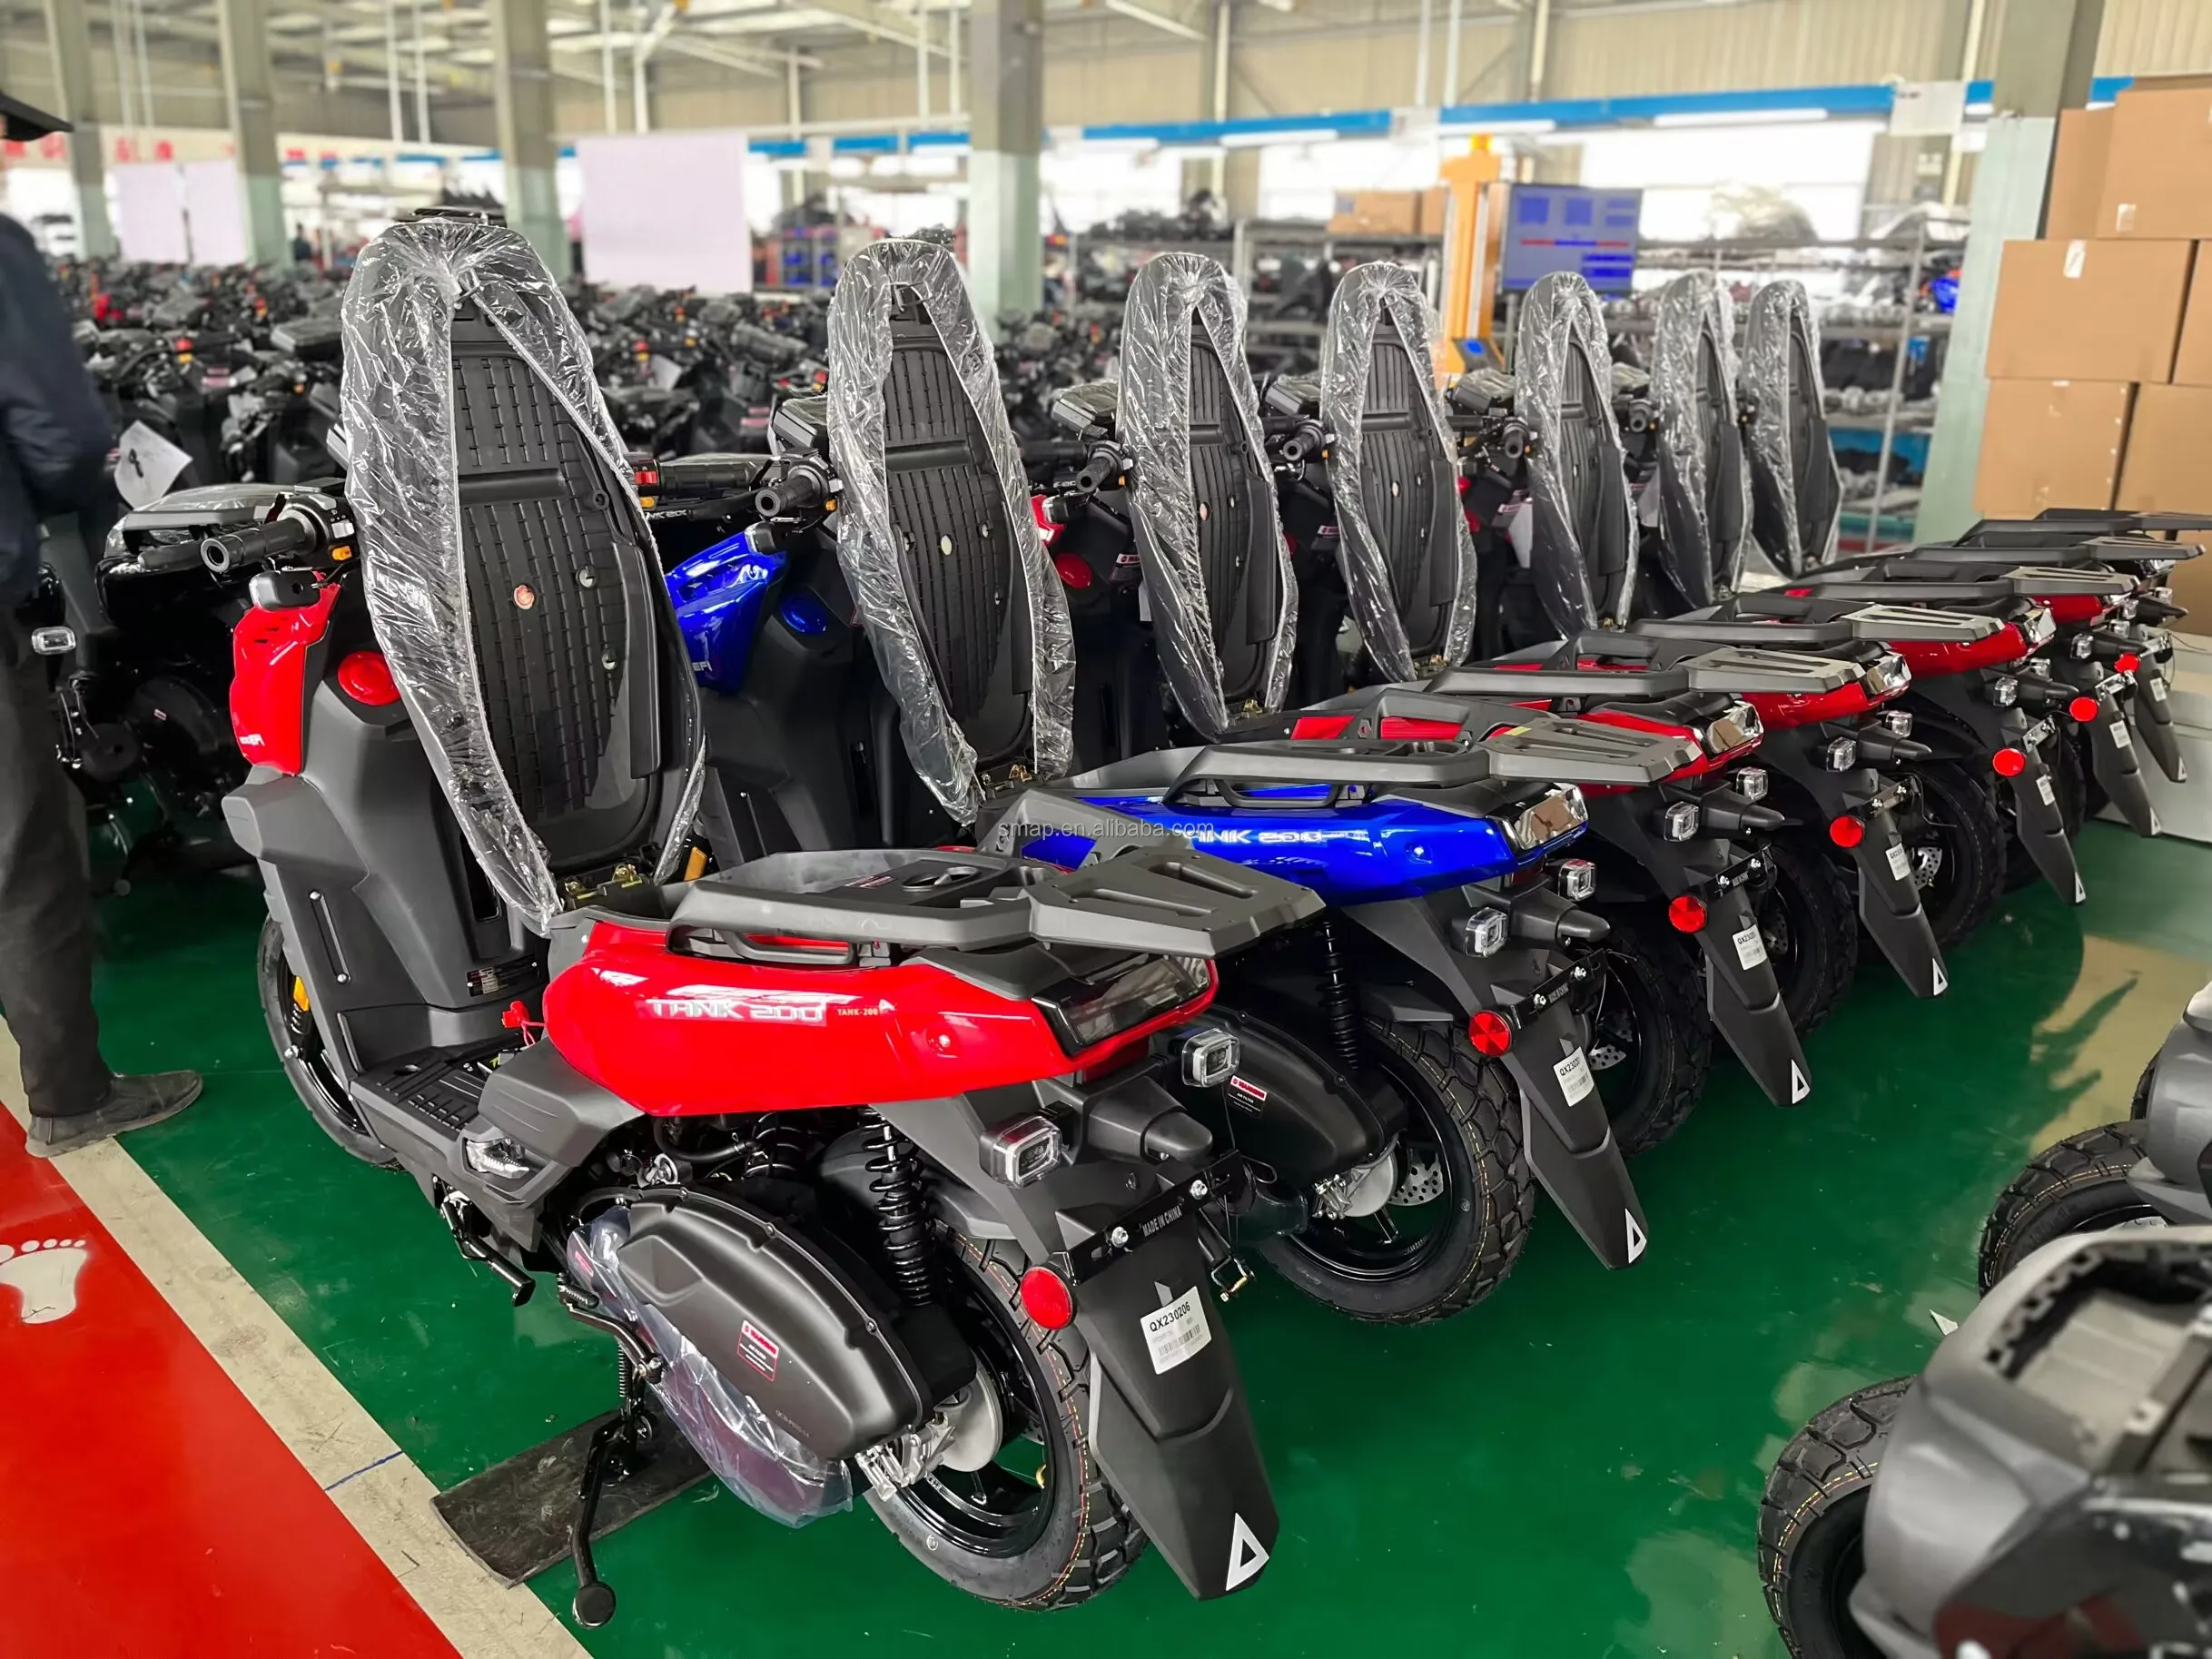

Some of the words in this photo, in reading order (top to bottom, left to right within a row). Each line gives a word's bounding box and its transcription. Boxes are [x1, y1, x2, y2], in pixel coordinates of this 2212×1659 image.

[646, 998, 746, 1020] TANK
[750, 1004, 825, 1022] 200
[1141, 1218, 1160, 1237] MADE
[1157, 1214, 1166, 1229] IN
[1163, 1205, 1182, 1224] CHINA
[1149, 1300, 1191, 1333] QX230206
